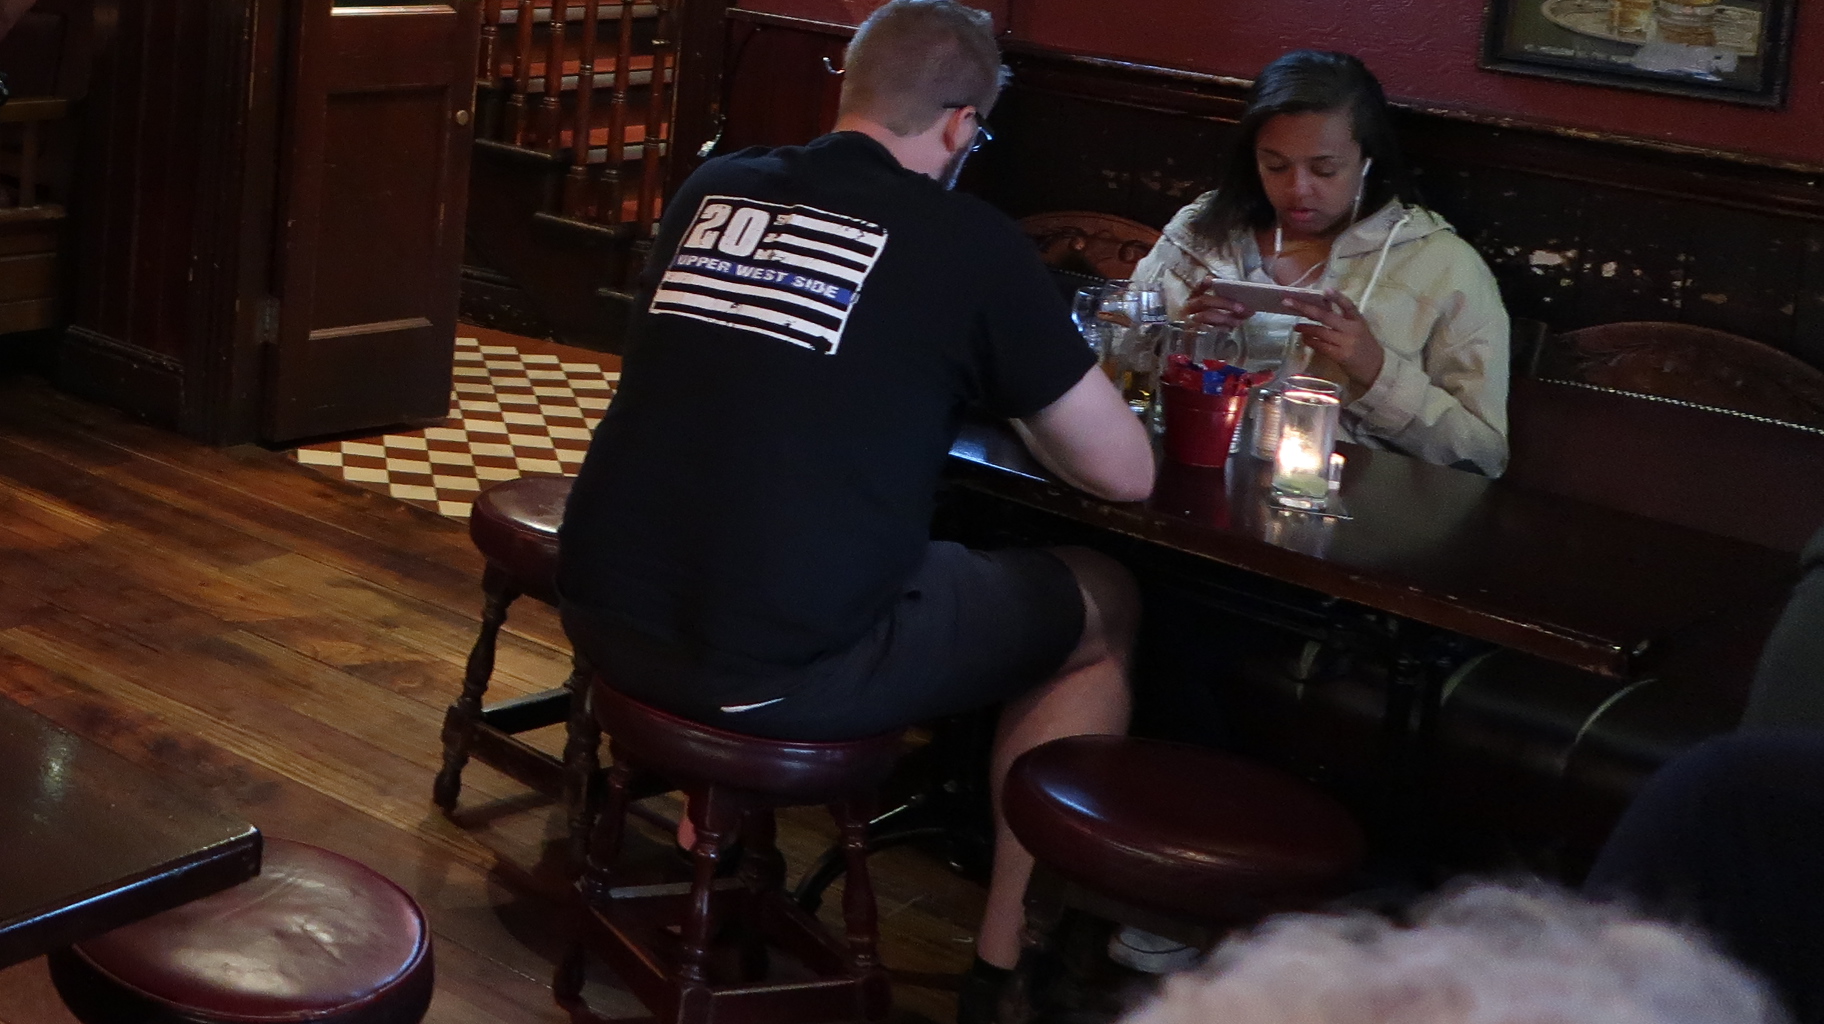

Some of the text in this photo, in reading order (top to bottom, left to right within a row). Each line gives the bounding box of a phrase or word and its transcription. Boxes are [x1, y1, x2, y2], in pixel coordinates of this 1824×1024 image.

[683, 203, 771, 258] 20
[676, 253, 841, 300] UPPER WEST SIDE
